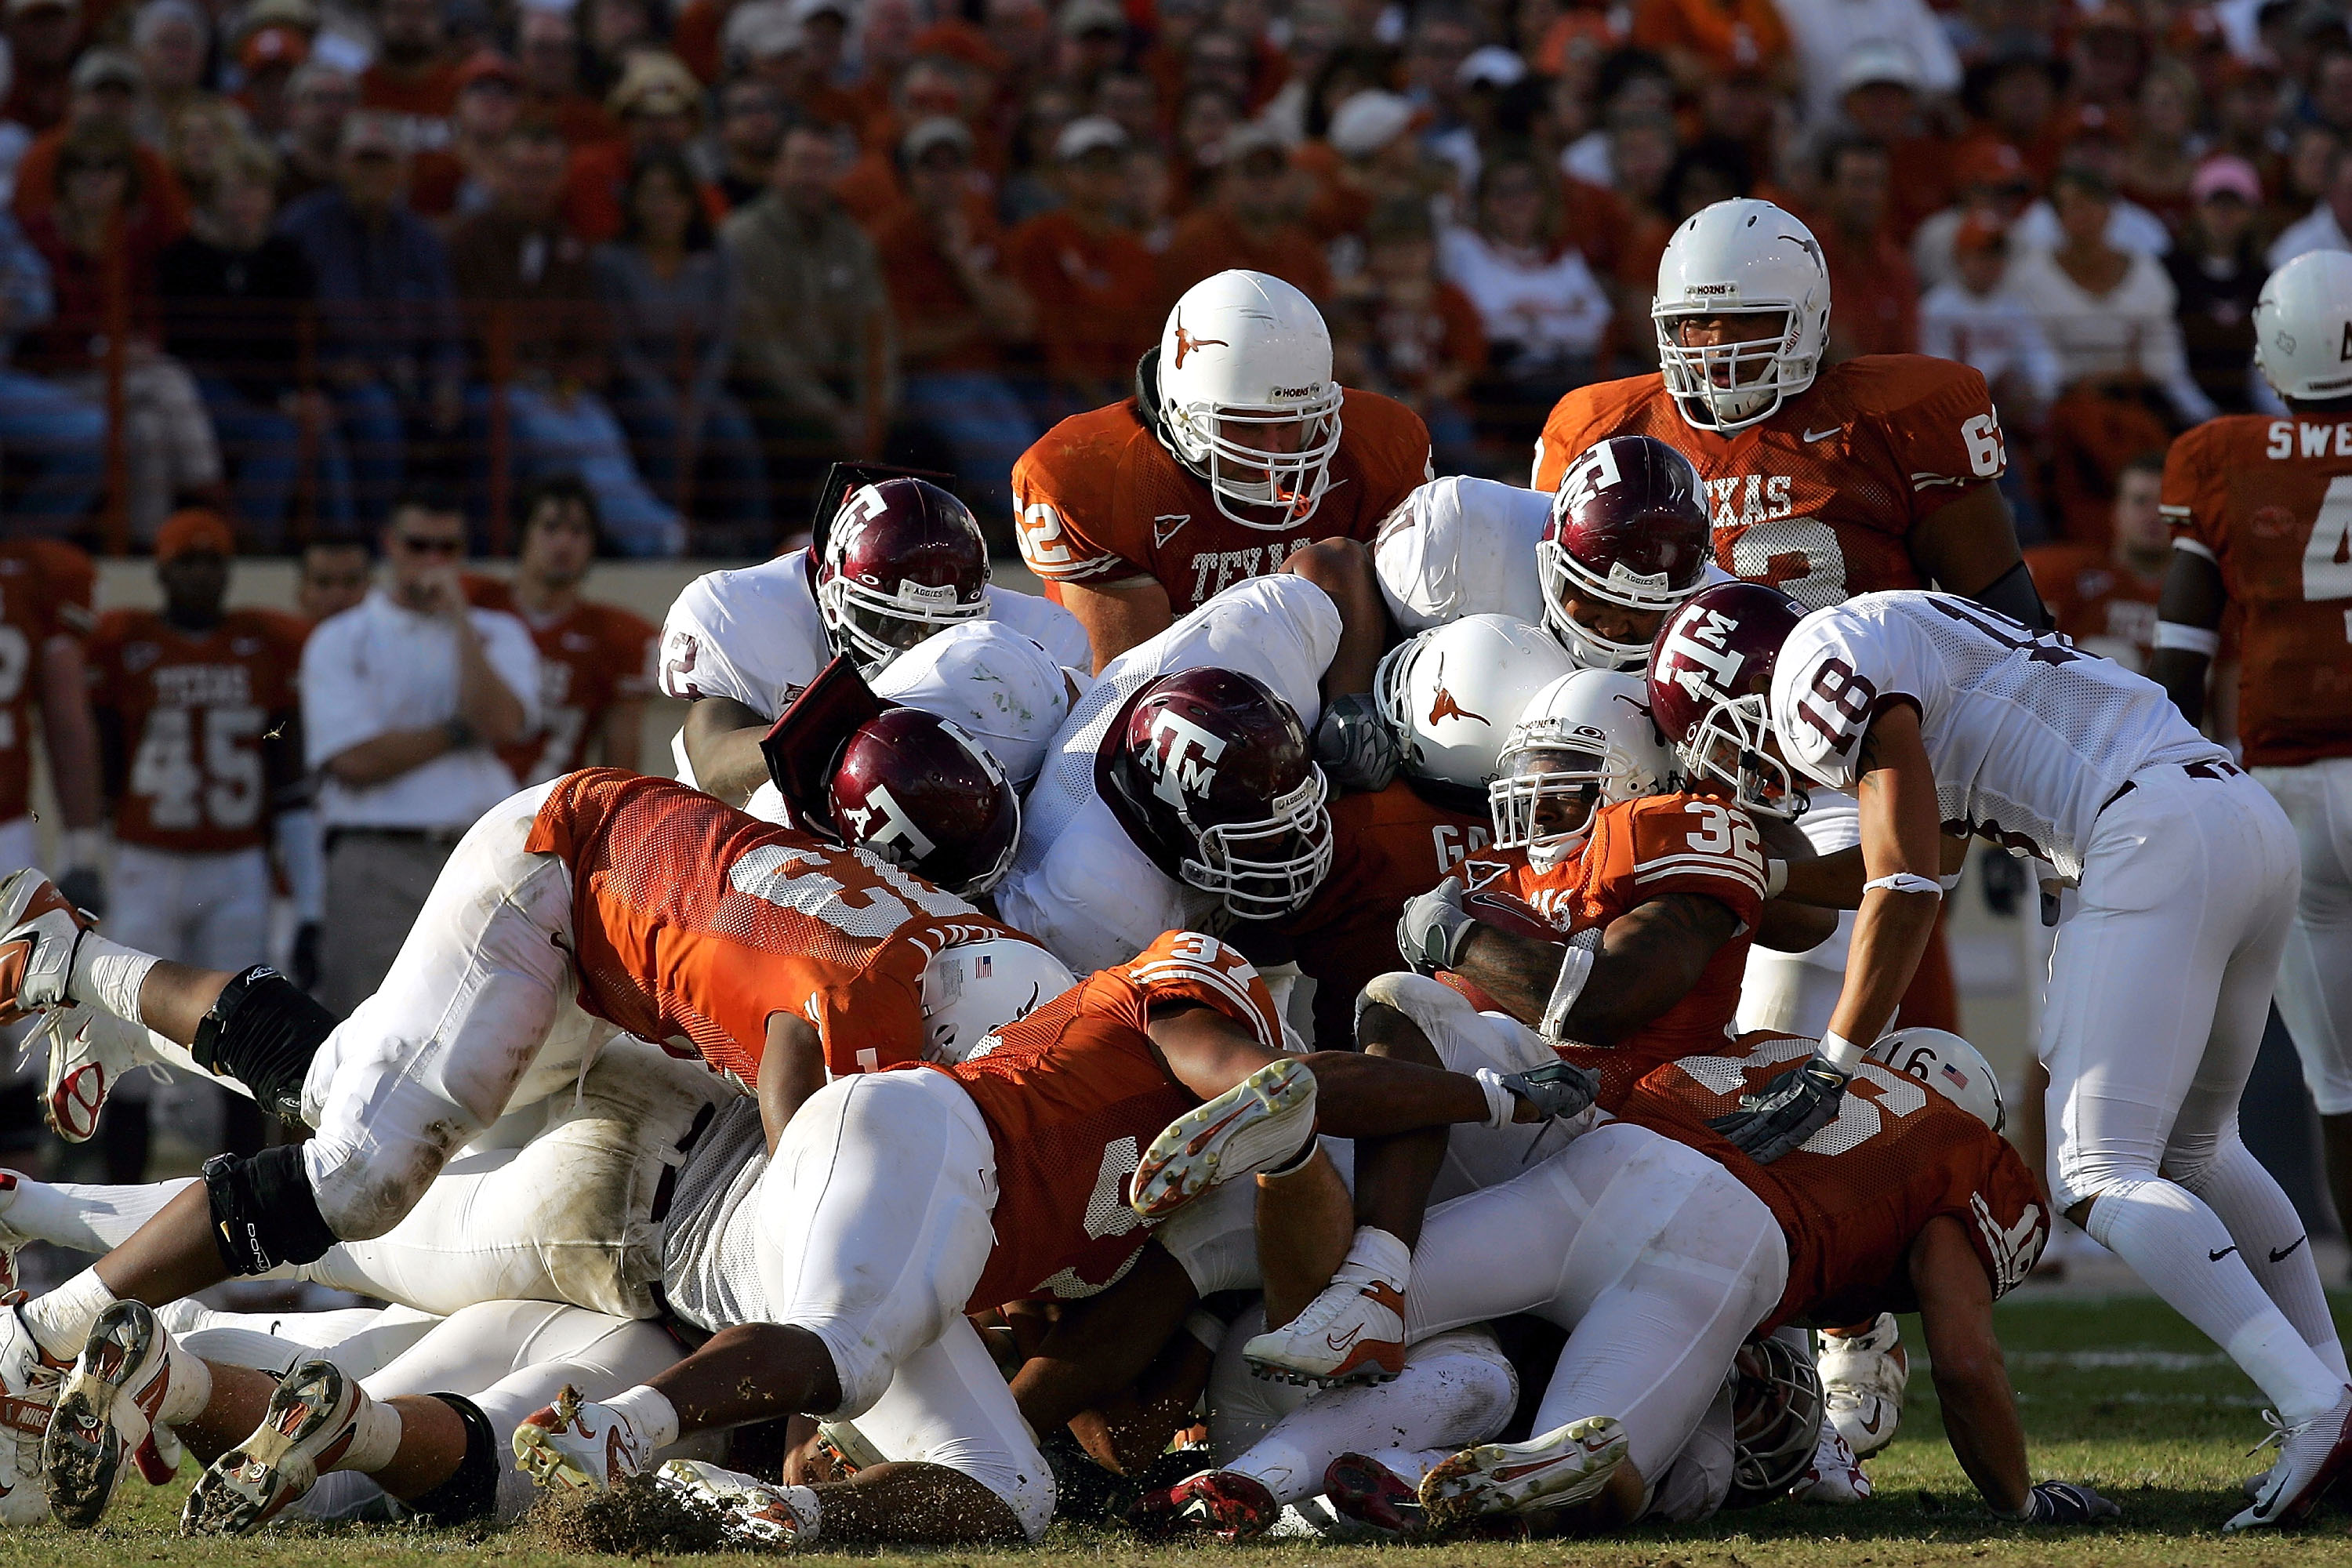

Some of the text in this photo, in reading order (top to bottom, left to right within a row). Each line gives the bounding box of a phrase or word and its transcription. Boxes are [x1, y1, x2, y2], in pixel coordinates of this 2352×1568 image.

[1697, 285, 1726, 295] HORNS
[1961, 403, 2007, 477] 6
[2267, 421, 2352, 459] SWE
[913, 587, 943, 597] AGGIES
[1624, 574, 1654, 586] AGGIES
[1707, 517, 1849, 612] 3
[1797, 657, 1877, 757] 18
[132, 707, 267, 827] 45
[1684, 801, 1763, 870] 32
[1884, 1040, 1938, 1082] 16
